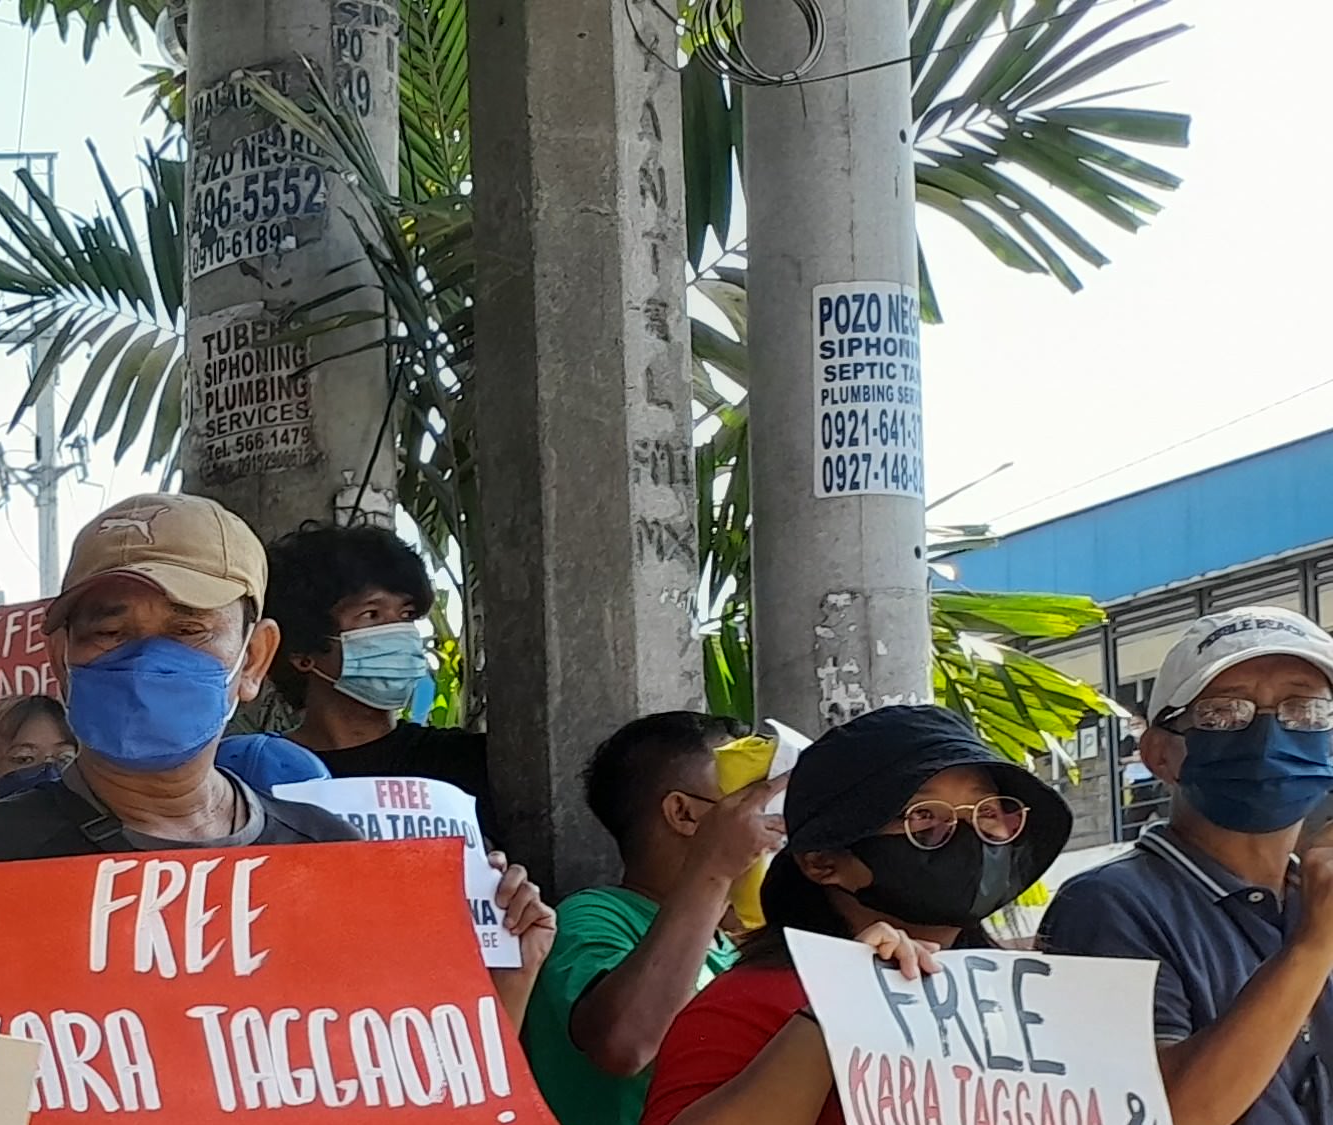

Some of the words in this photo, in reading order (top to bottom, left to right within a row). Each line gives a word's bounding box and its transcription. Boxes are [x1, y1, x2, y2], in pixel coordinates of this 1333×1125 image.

[819, 293, 882, 337] POZO
[204, 344, 307, 389] SIPHONING
[823, 362, 897, 384] SEPTIC
[205, 374, 309, 418] PLUMBING
[821, 384, 895, 407] PLUMBING
[205, 401, 310, 438] SERVICES
[373, 779, 432, 810] FREE
[88, 854, 272, 979] FREE
[873, 955, 1067, 1076] FREE
[185, 996, 517, 1124] TAGGAOA!
